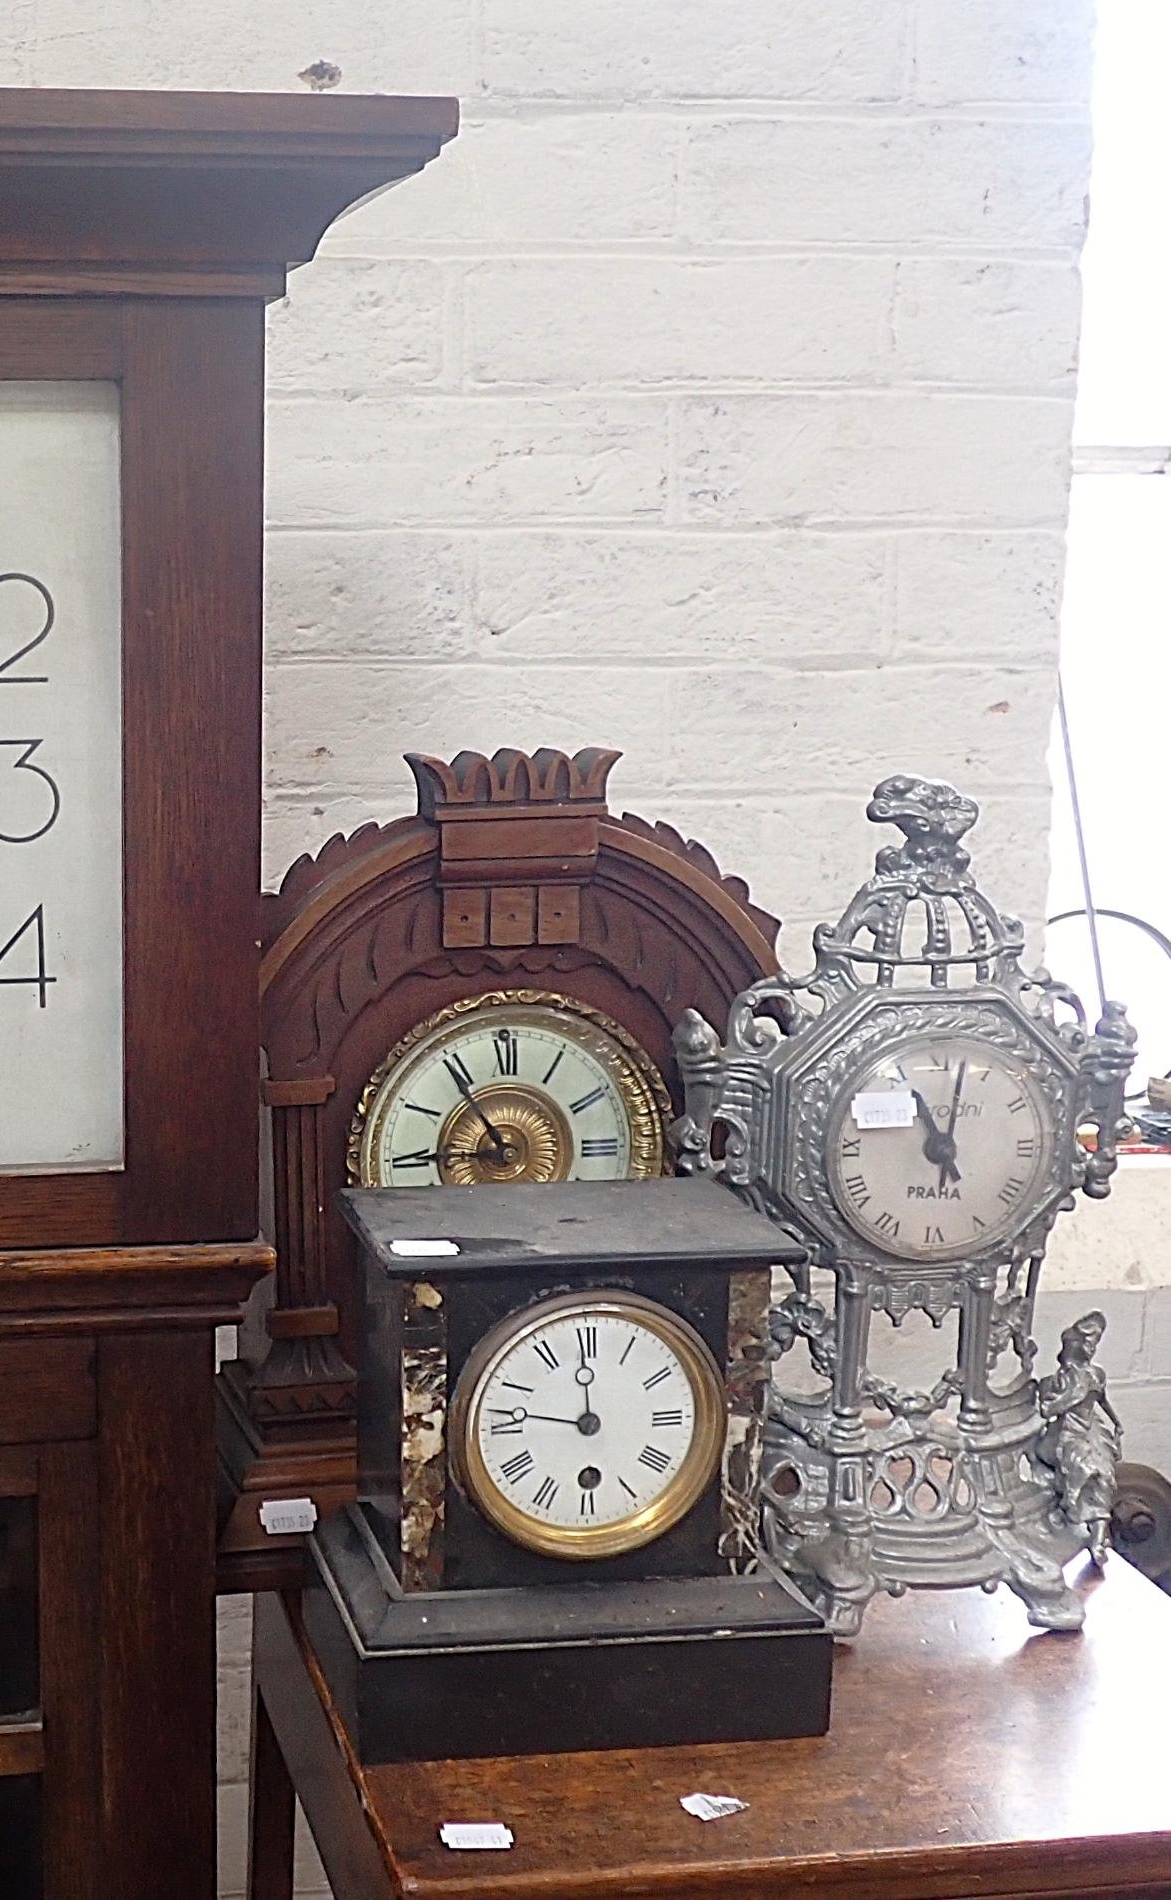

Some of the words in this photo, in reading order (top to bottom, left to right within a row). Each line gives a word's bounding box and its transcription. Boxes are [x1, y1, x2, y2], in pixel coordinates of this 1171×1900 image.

[581, 1138, 618, 1158] III
[842, 1138, 861, 1157] IX
[1017, 1139, 1033, 1158] III
[907, 1186, 962, 1200] PRAHA
[874, 1212, 900, 1236] VII
[972, 1215, 986, 1233] V
[924, 1227, 945, 1243] VI
[642, 1366, 672, 1390] II
[652, 1410, 682, 1427] III
[638, 1445, 672, 1473] IIII
